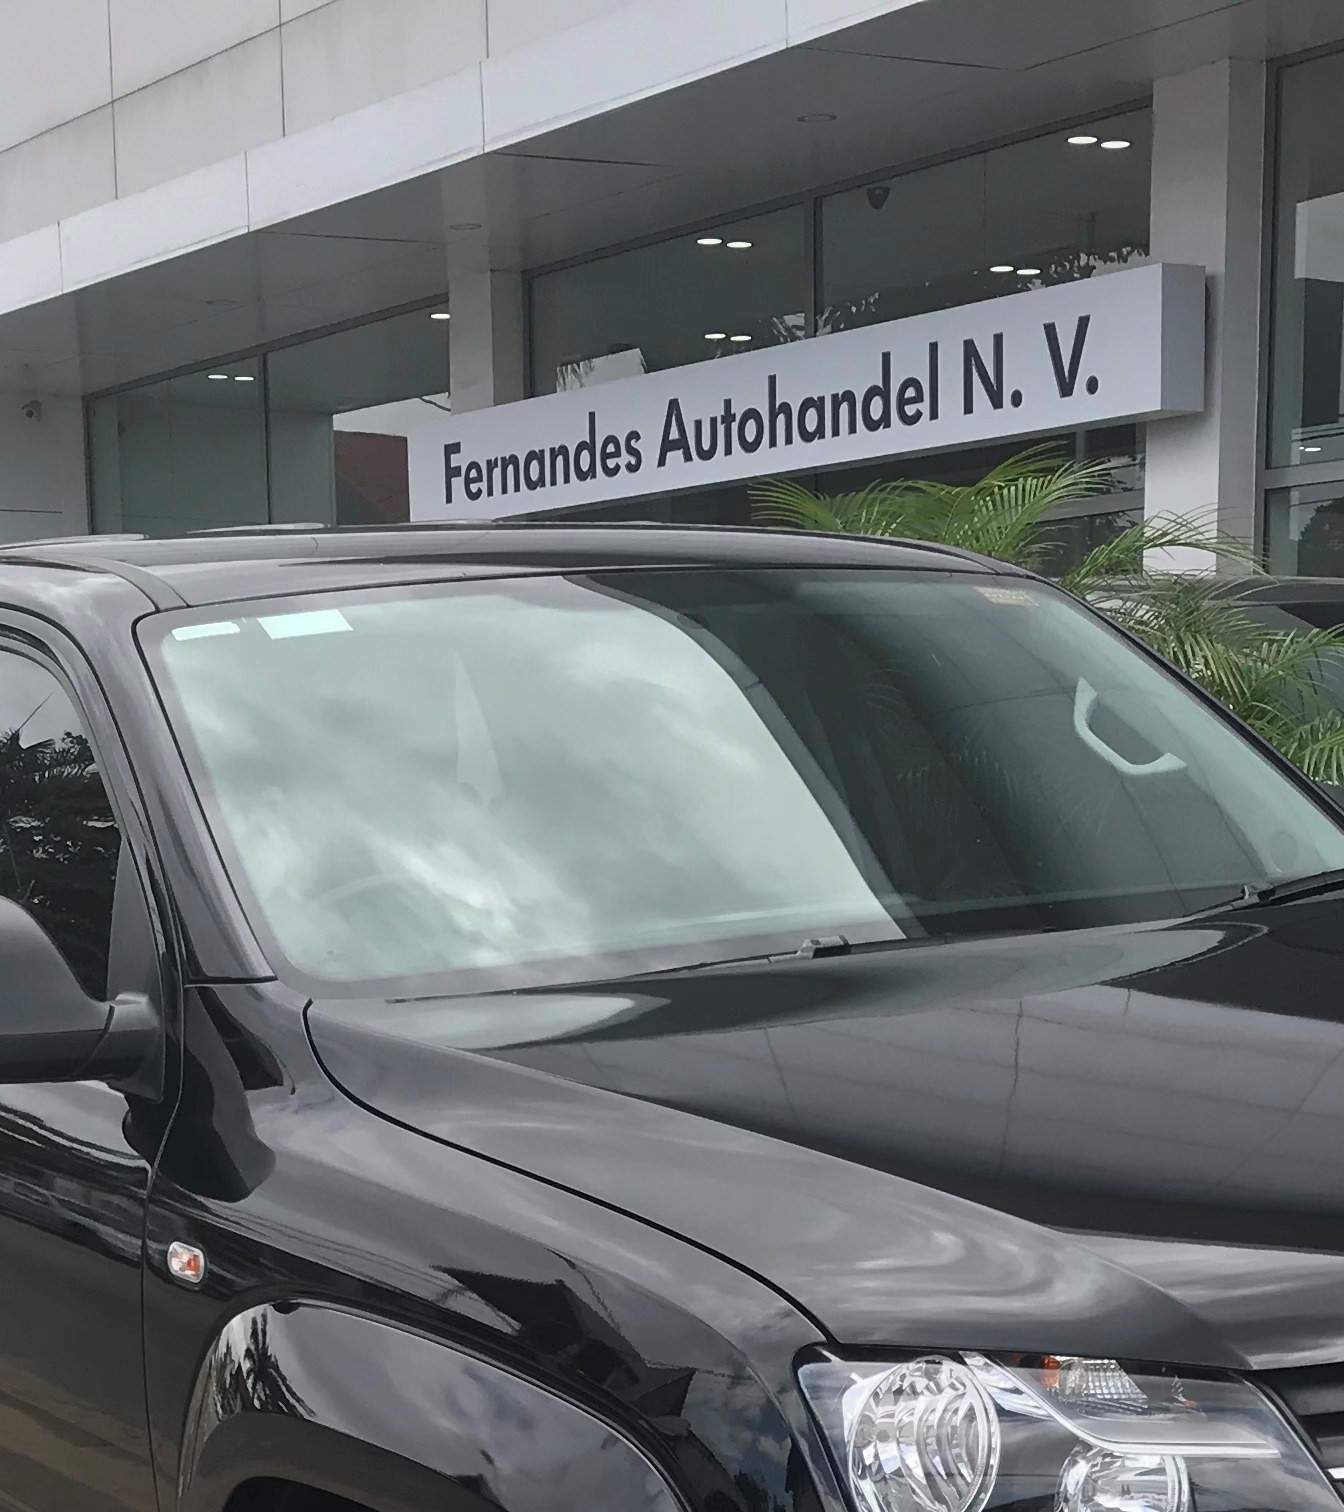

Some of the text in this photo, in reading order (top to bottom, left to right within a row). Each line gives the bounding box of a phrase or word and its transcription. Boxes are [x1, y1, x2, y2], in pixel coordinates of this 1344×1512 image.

[444, 314, 1100, 505] Fernandes Autohandel N. V.
